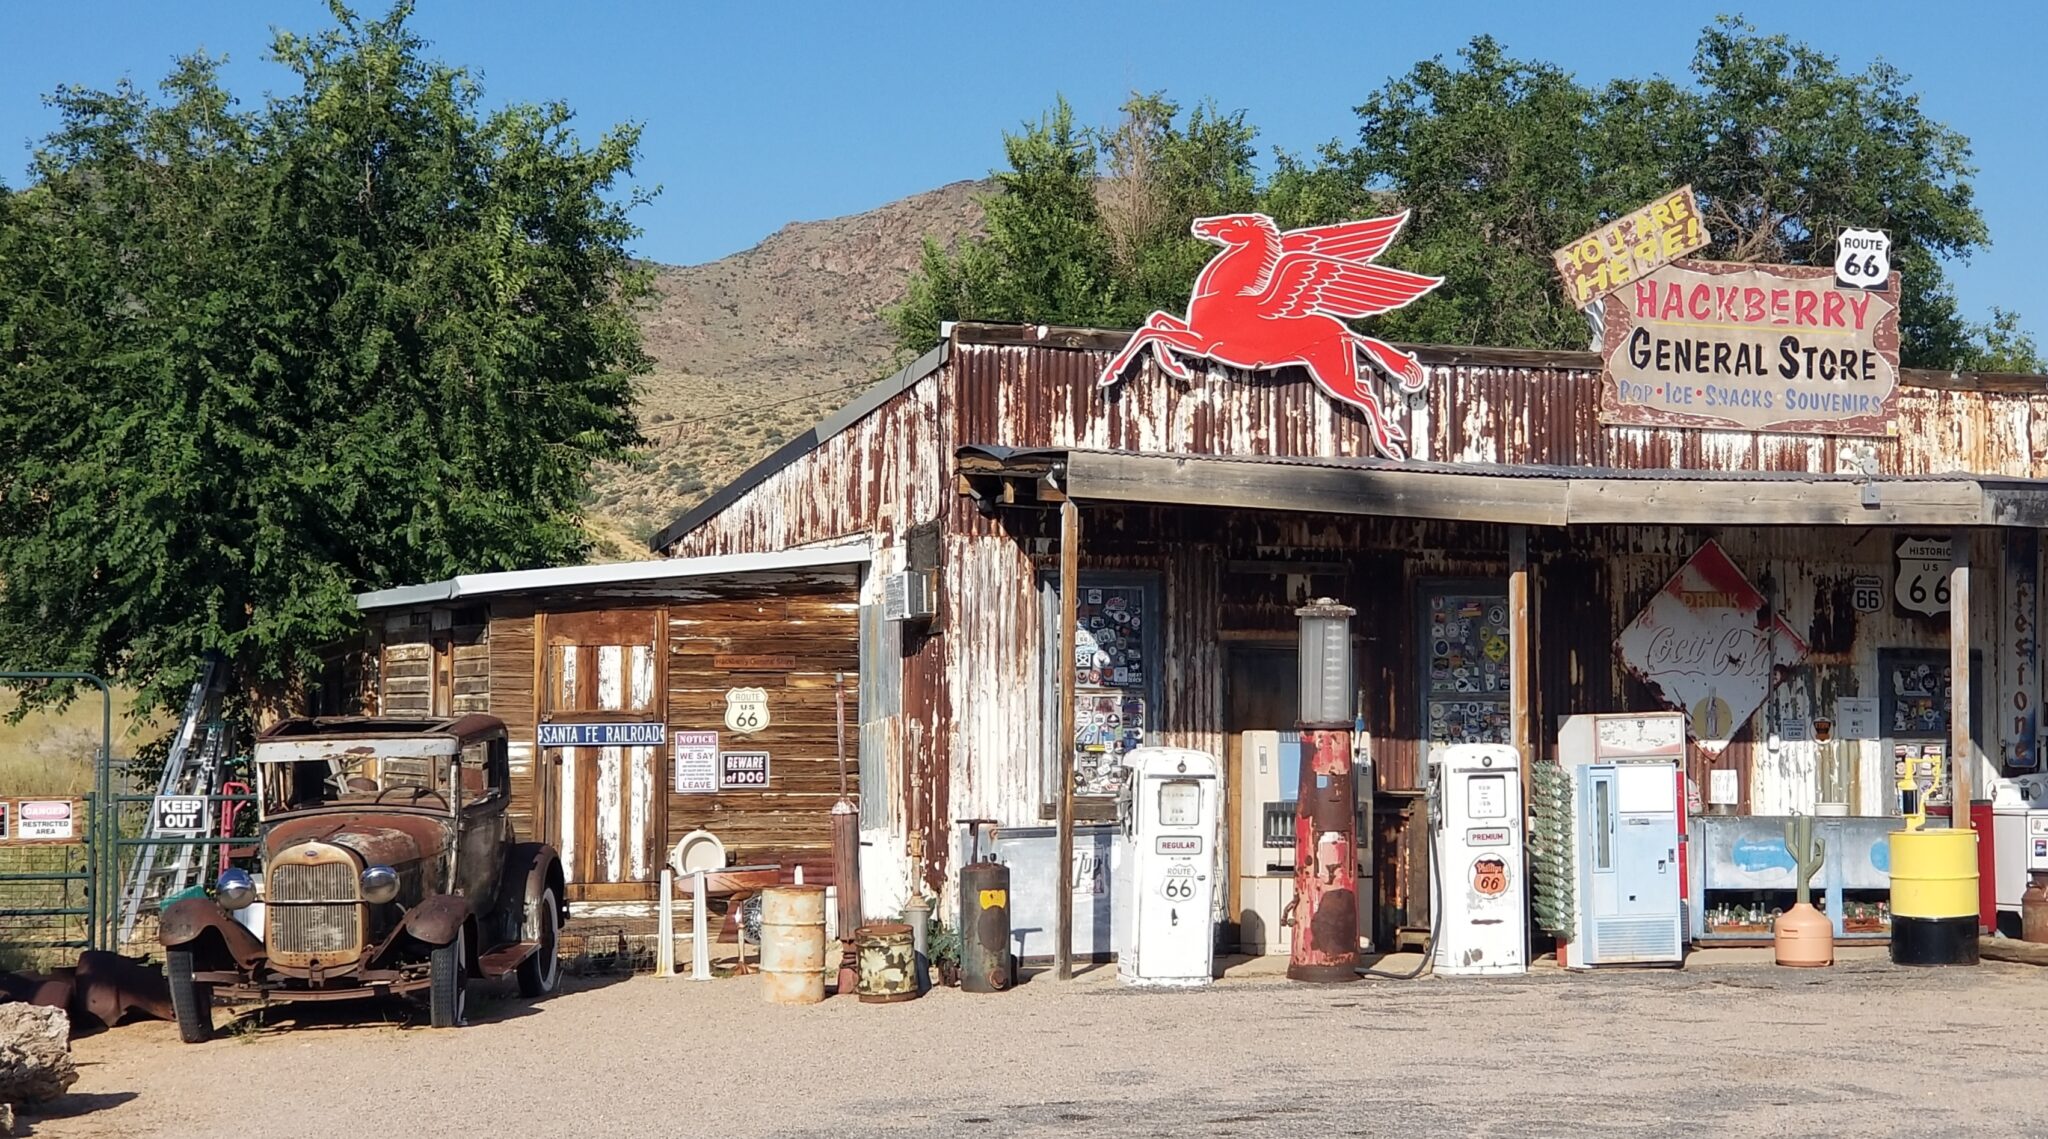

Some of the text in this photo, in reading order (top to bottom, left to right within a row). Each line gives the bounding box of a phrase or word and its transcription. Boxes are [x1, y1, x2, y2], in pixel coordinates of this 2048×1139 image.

[1635, 195, 1689, 239] ARE
[1843, 237, 1884, 251] ROUTE
[1844, 253, 1881, 278] 66
[1634, 279, 1872, 330] HACKBERRY
[1628, 326, 1877, 381] GENERAL STORE
[1619, 379, 1882, 414] POP ICE SNACKS SOUVENIRS
[1909, 546, 1952, 557] HISTORIC
[1909, 574, 1952, 605] 66
[1681, 591, 1739, 608] DRINK
[1855, 589, 1880, 609] 66
[735, 693, 760, 701] ROUTE
[736, 712, 758, 728] 66
[543, 725, 661, 743] SANTA FE RAILROAD
[679, 735, 715, 744] NOTICE
[680, 752, 714, 760] WE SAY
[727, 756, 764, 769] BEWARE
[726, 771, 764, 783] of DOG
[682, 781, 712, 789] LEAVE
[24, 806, 67, 816] DANGER
[160, 800, 202, 814] KEEP
[22, 820, 69, 828] RESTRICTED
[164, 814, 198, 828] OUT
[1471, 833, 1504, 841] PREMIUM
[1161, 841, 1196, 850] REGULAR
[1167, 867, 1192, 876] ROUTE
[1166, 878, 1192, 898] 66
[1480, 876, 1500, 890] 66
